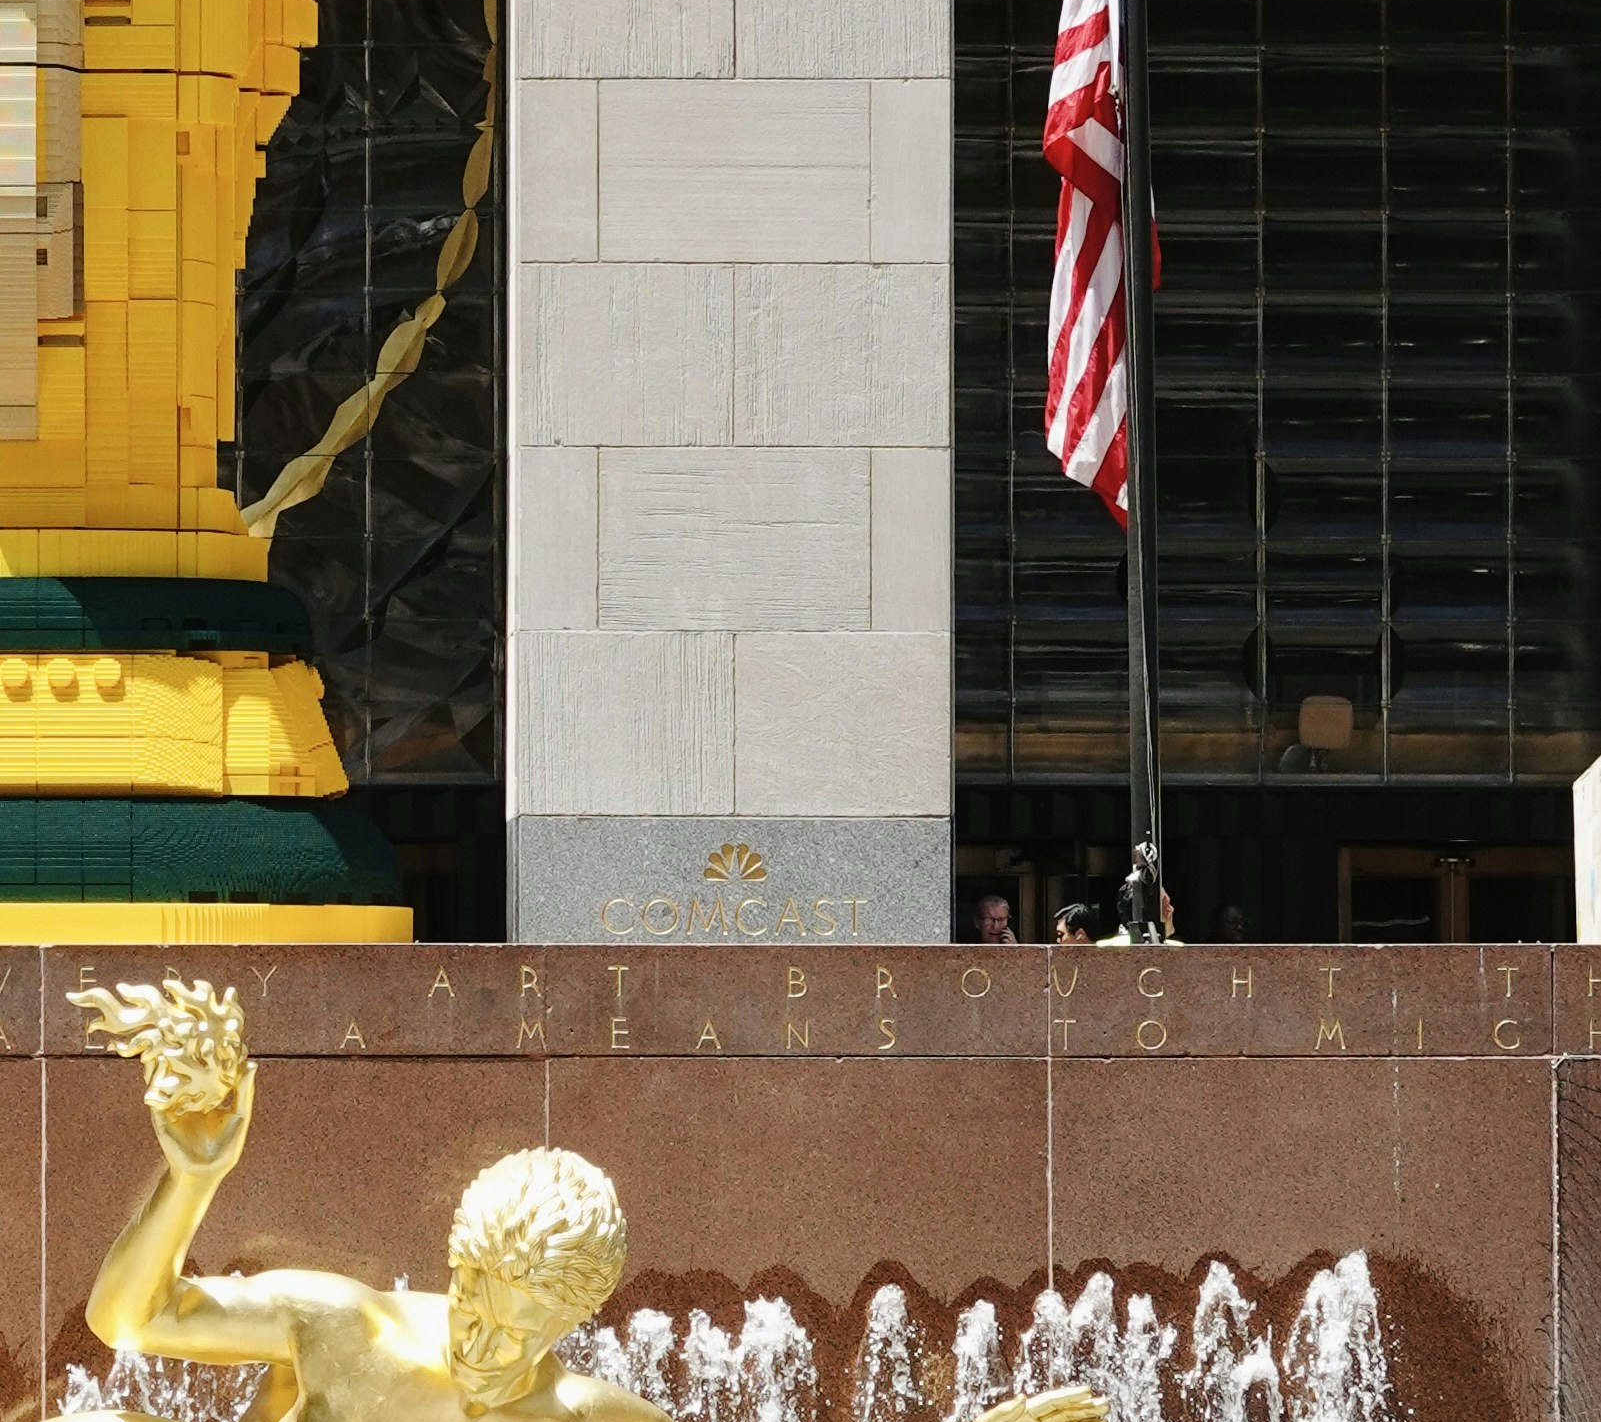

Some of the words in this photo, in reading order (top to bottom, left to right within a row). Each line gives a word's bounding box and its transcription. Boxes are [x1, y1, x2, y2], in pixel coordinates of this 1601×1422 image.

[601, 897, 868, 939] COMCAST
[427, 964, 631, 998] ART
[787, 965, 1343, 999] BROUGHT
[338, 1018, 367, 1051] A
[515, 1018, 898, 1051] MEANS
[1053, 1018, 1168, 1051] TO
[1313, 1017, 1601, 1051] MIGH
